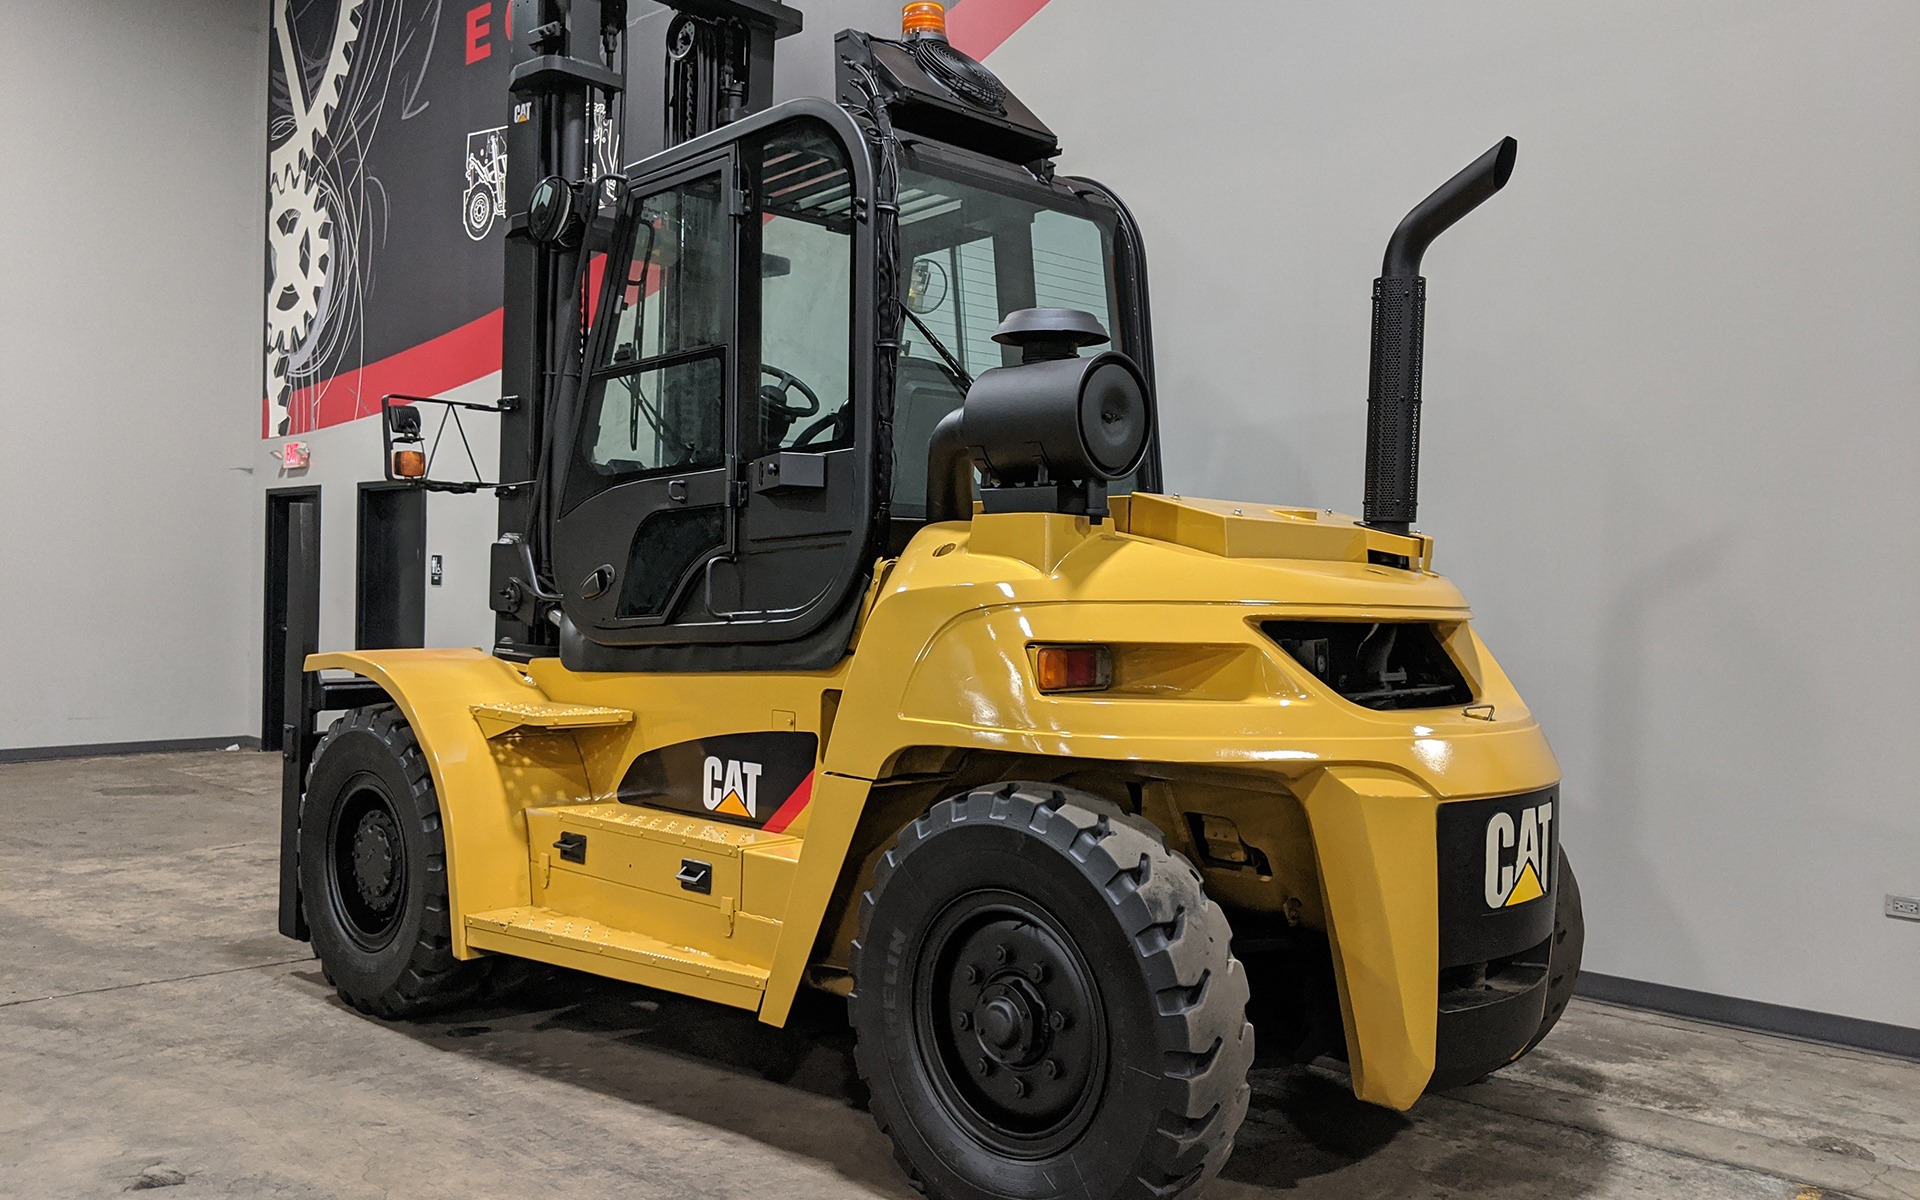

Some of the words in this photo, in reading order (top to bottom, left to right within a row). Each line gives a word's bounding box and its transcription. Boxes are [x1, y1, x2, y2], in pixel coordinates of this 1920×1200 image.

[465, 2, 512, 65] E
[514, 101, 532, 123] CAT
[703, 755, 762, 819] CAT
[1484, 801, 1552, 909] CAT
